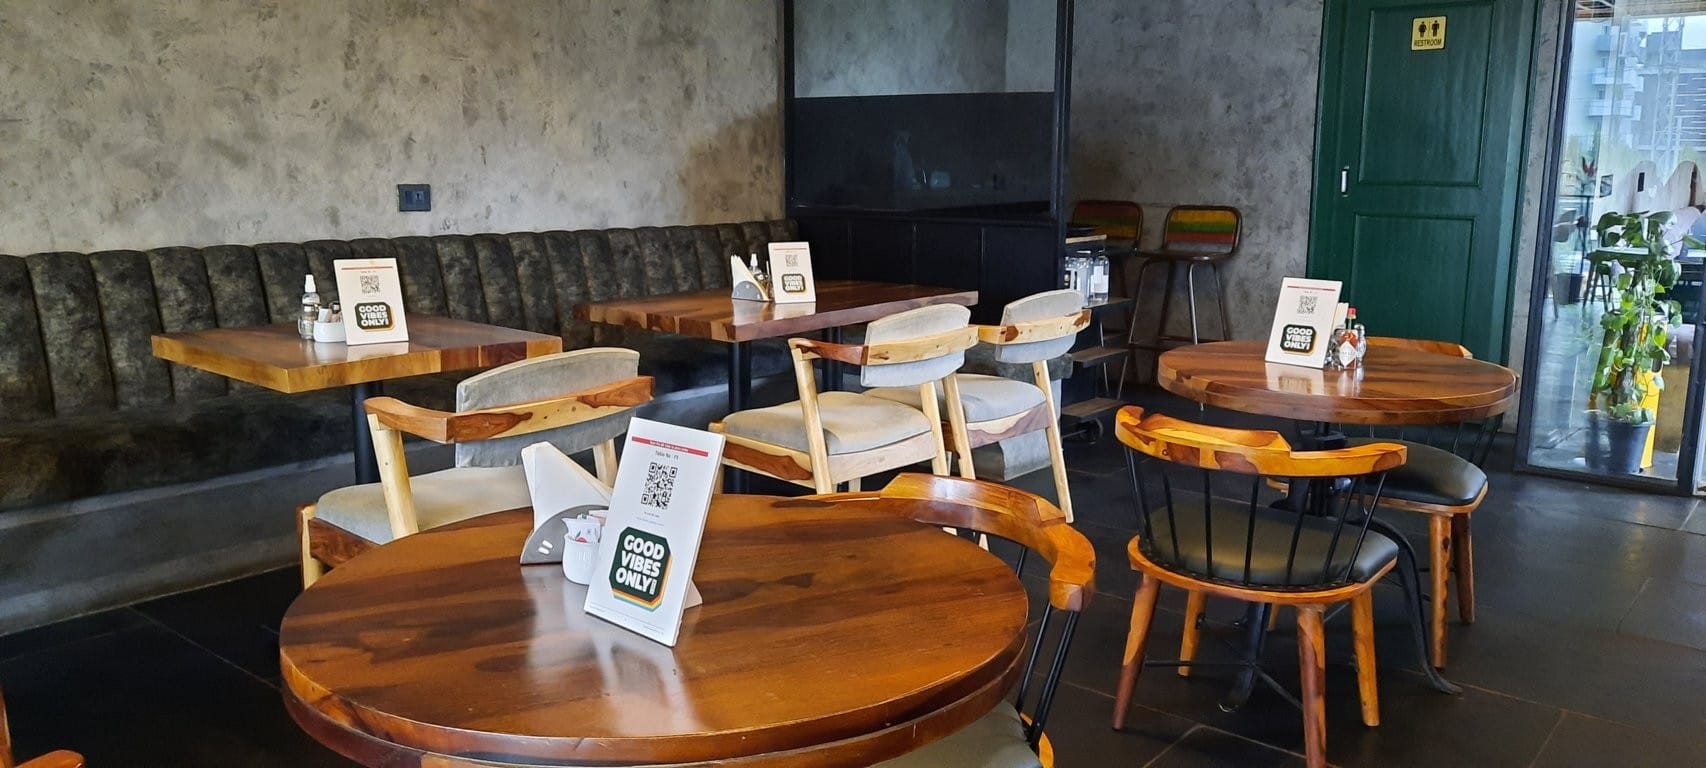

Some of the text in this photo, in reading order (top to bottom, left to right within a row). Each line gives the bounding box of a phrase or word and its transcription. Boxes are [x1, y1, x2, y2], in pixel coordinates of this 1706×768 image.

[1414, 38, 1442, 47] RESTROOM
[359, 305, 386, 313] GOOD
[360, 311, 388, 320] VIBES
[361, 318, 389, 327] ONLY!
[1286, 327, 1313, 336] GOOD
[1285, 333, 1312, 343] VIBES
[1284, 341, 1311, 350] ONLY!
[623, 534, 665, 560] GOOD
[621, 550, 662, 577] VIBES
[615, 567, 658, 595] ONLY!
